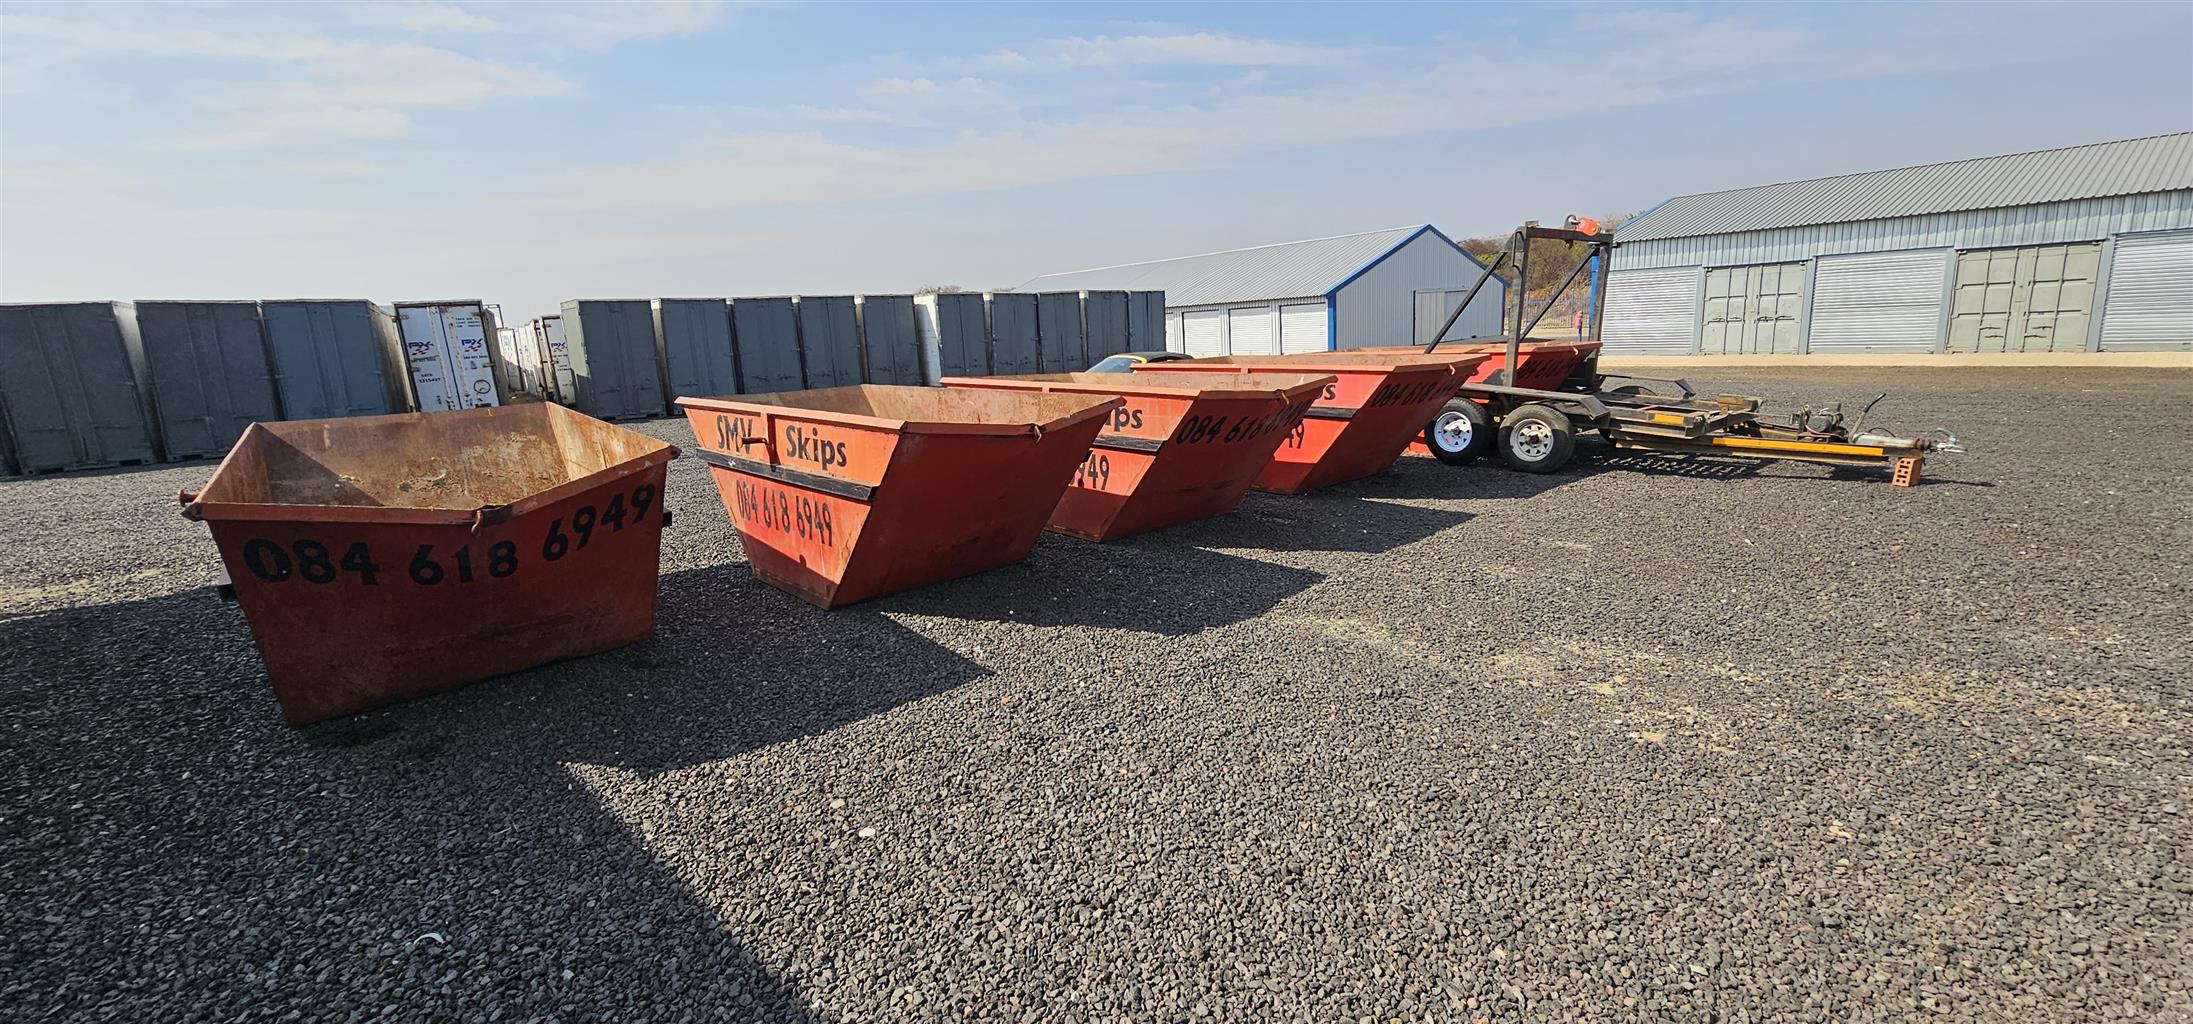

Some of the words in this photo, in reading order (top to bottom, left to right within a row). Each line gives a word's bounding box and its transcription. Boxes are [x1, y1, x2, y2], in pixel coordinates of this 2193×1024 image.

[716, 415, 752, 454] SMV
[786, 425, 847, 470] Skips
[1176, 415, 1228, 444] 084
[1224, 414, 1269, 443] 618
[243, 538, 381, 585] 084
[409, 540, 518, 586] 618
[542, 483, 656, 562] 6949
[736, 479, 759, 525] 084
[763, 487, 791, 533] 618
[796, 495, 832, 547] 6949
